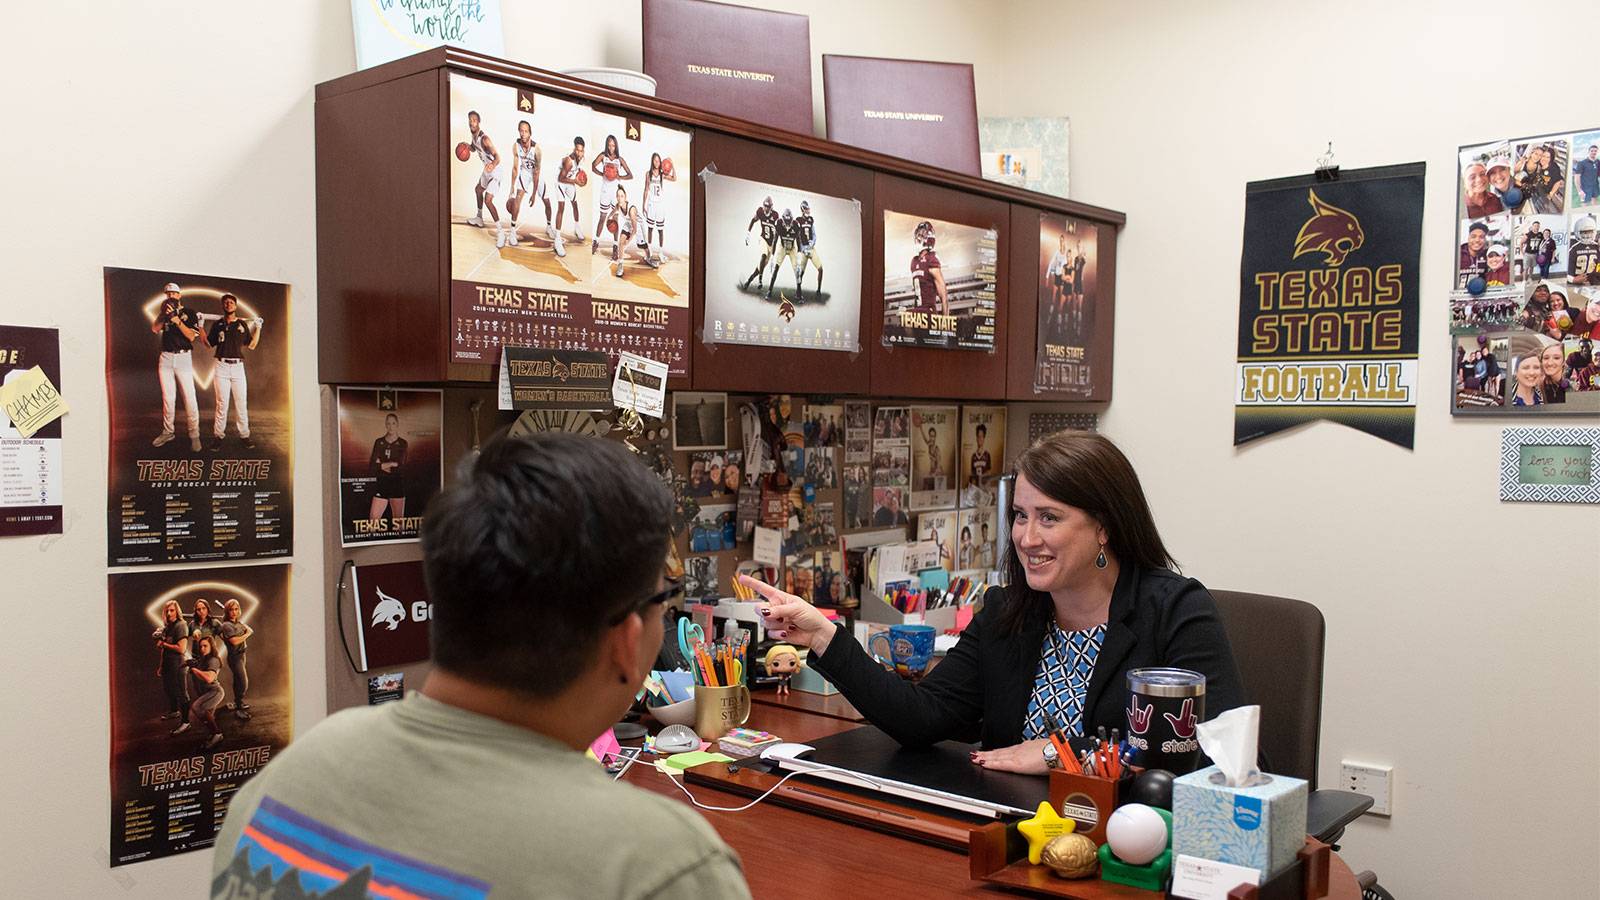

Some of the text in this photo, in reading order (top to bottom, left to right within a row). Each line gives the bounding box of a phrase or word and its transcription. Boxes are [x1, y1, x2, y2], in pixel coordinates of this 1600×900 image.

[688, 64, 775, 82] TEXAS STATE UNIVERSITY
[864, 110, 944, 122] TEXAS STATE UNIVERSITY
[1255, 264, 1402, 311] TEXAS
[475, 286, 569, 312] TEXAS STATE
[497, 307, 519, 315] BOBCAT
[540, 311, 573, 320] BASKETBALL
[591, 301, 669, 324] TEXAS STATE
[899, 311, 957, 331] TEXAS STATE
[1252, 310, 1402, 354] STATE
[1045, 344, 1065, 357] TEXAS
[1066, 346, 1084, 360] STATE
[510, 360, 607, 378] TEXAS STATE
[1242, 363, 1409, 403] FOOTBALL
[6, 380, 57, 422] CHAMPS
[514, 389, 555, 402] WOMEN'S
[557, 391, 609, 402] BASKETBALL
[137, 459, 271, 481] TEXAS STATE
[1528, 454, 1592, 470] love you
[1561, 466, 1591, 479] much
[352, 518, 388, 533] TEXAS
[1161, 739, 1198, 753] state
[139, 745, 271, 787] TEXAS STATE
[180, 775, 213, 787] BOBCAT
